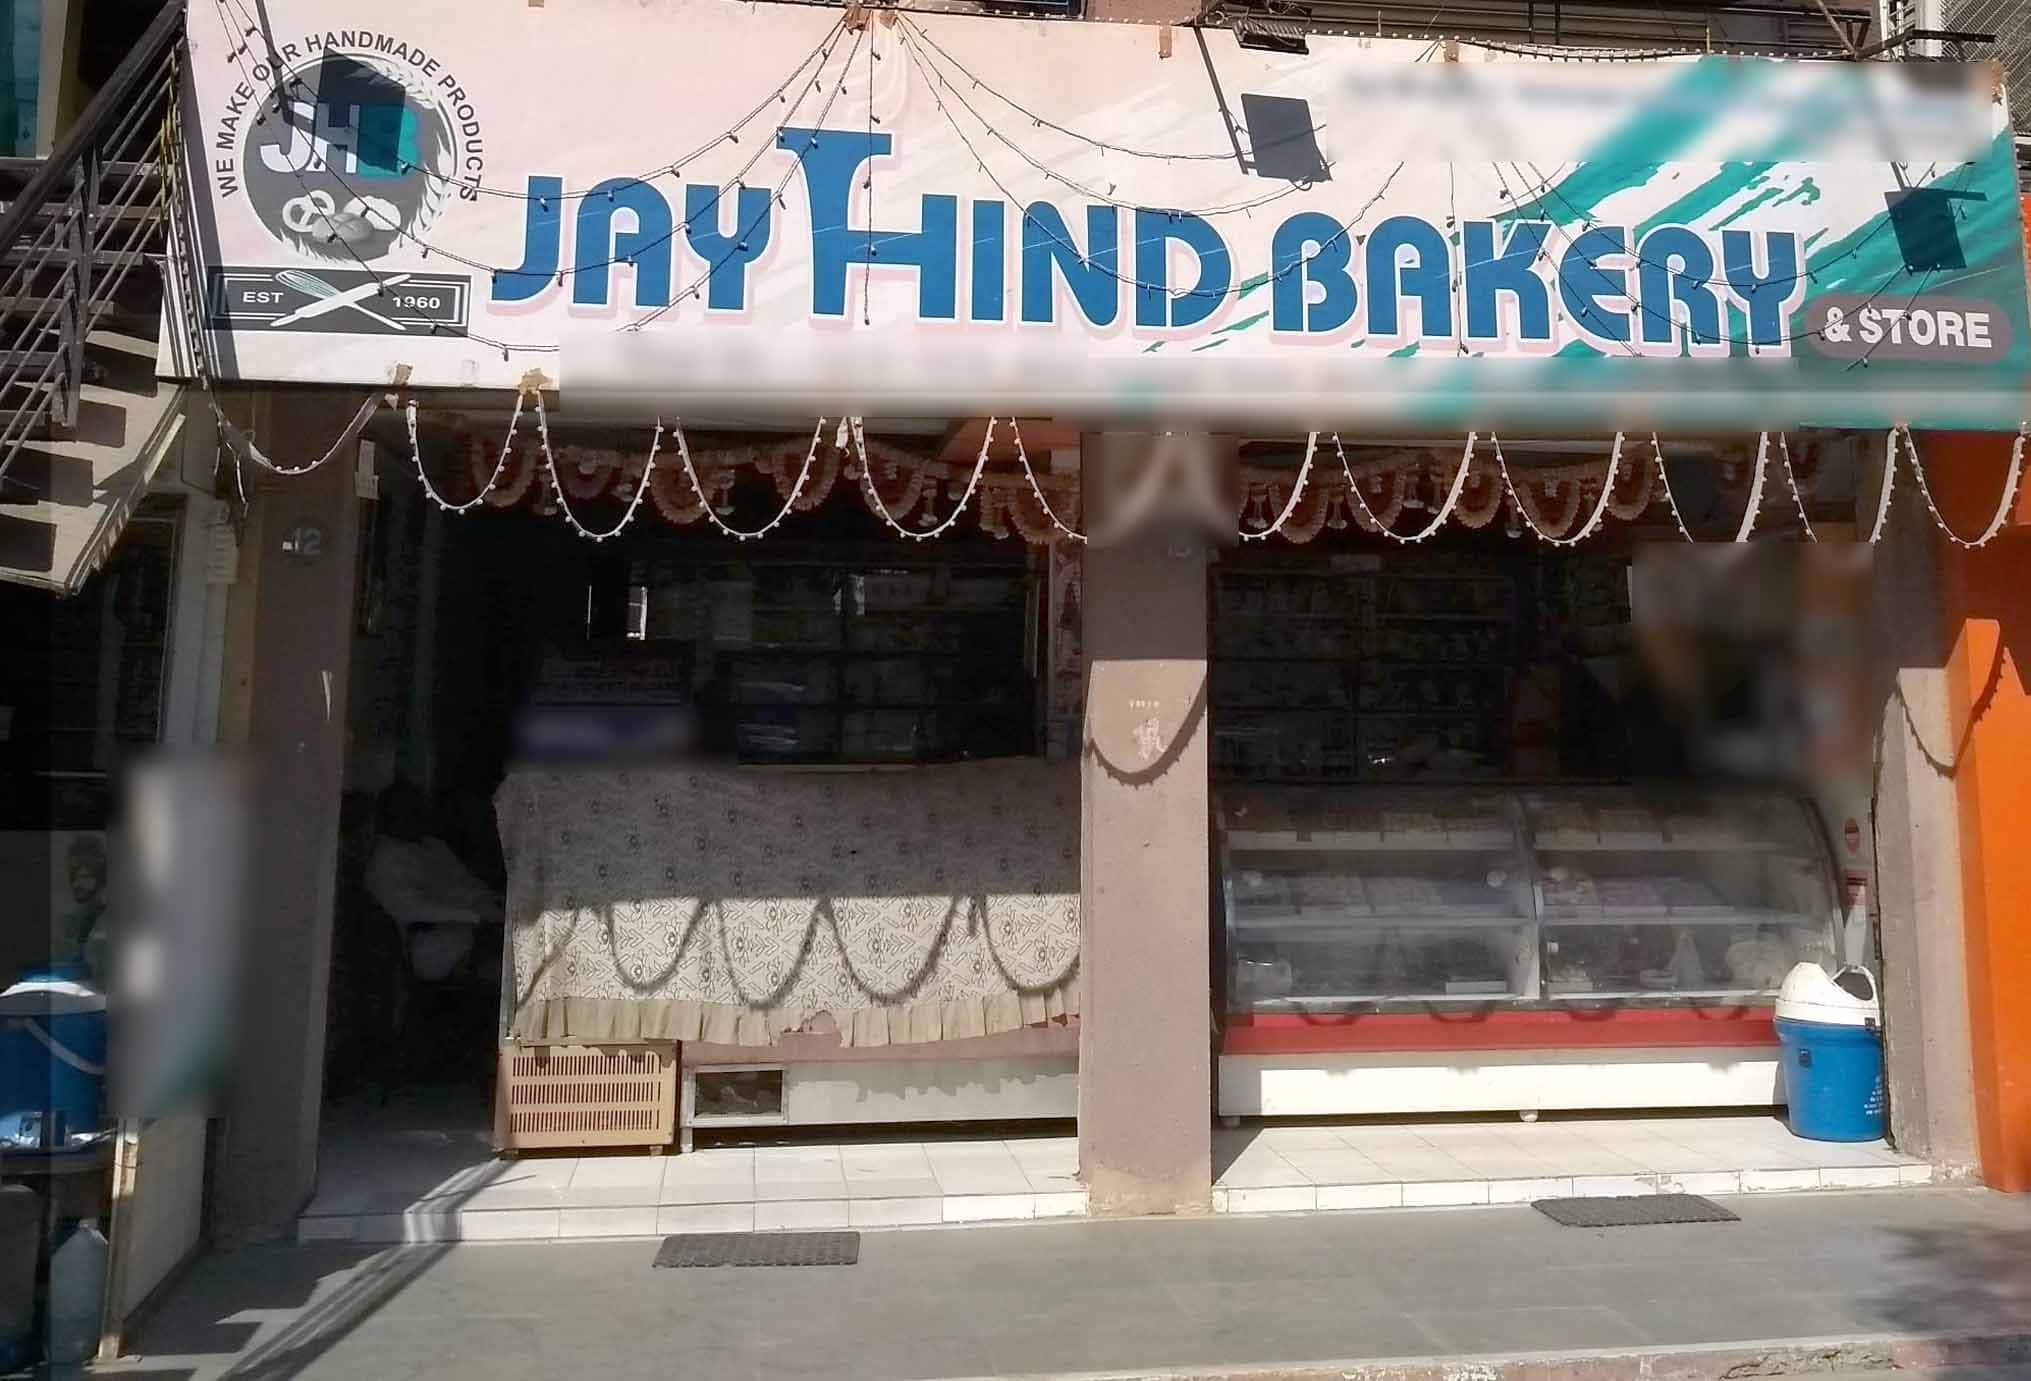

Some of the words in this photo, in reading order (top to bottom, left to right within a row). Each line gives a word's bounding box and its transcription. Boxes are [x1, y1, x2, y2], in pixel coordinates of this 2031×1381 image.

[305, 30, 440, 77] HANDMADE
[216, 82, 256, 151] MAKE
[437, 76, 484, 202] PRODUCTS
[216, 157, 239, 199] WE
[491, 174, 772, 312] JAY
[775, 127, 1232, 328] HIND
[1271, 210, 1797, 346] BAKERY
[242, 291, 284, 304] EST
[392, 296, 441, 310] 1960
[1824, 306, 1852, 343] &
[1858, 307, 1993, 348] STORE
